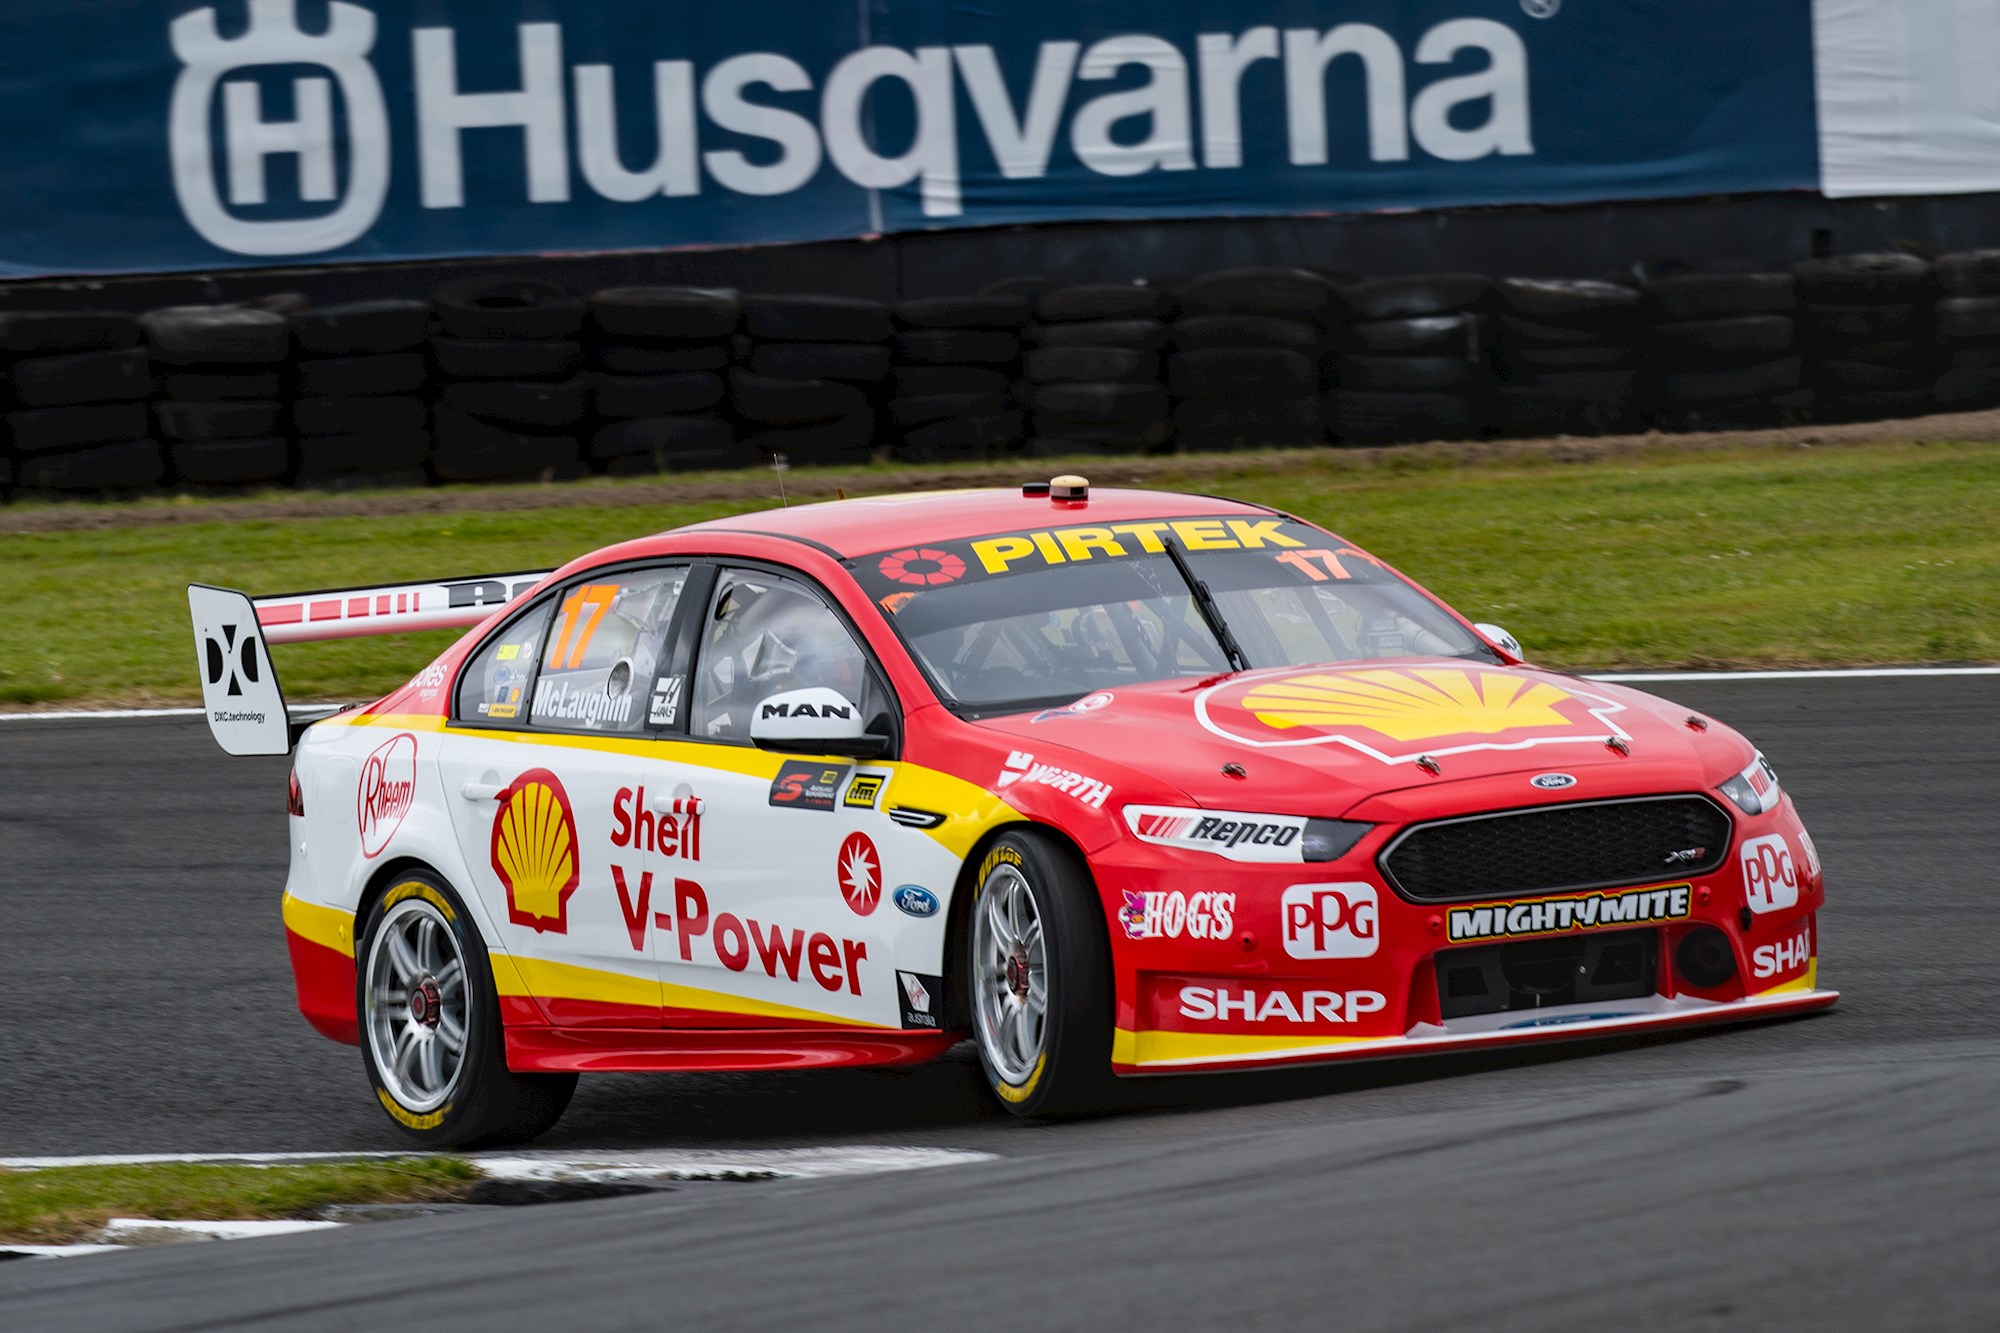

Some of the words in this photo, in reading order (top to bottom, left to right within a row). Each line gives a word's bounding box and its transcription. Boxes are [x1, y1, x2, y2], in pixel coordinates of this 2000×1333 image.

[412, 17, 1535, 217] Husqvarna
[969, 519, 1307, 576] PIRTEK
[1275, 549, 1352, 582] 17
[549, 584, 621, 670] 17
[761, 703, 851, 721] MAN
[363, 755, 412, 836] Rheem
[610, 785, 701, 862] Shell
[610, 863, 868, 997] V-Power
[901, 888, 932, 913] Ford
[1178, 985, 1388, 1023] SHARP
